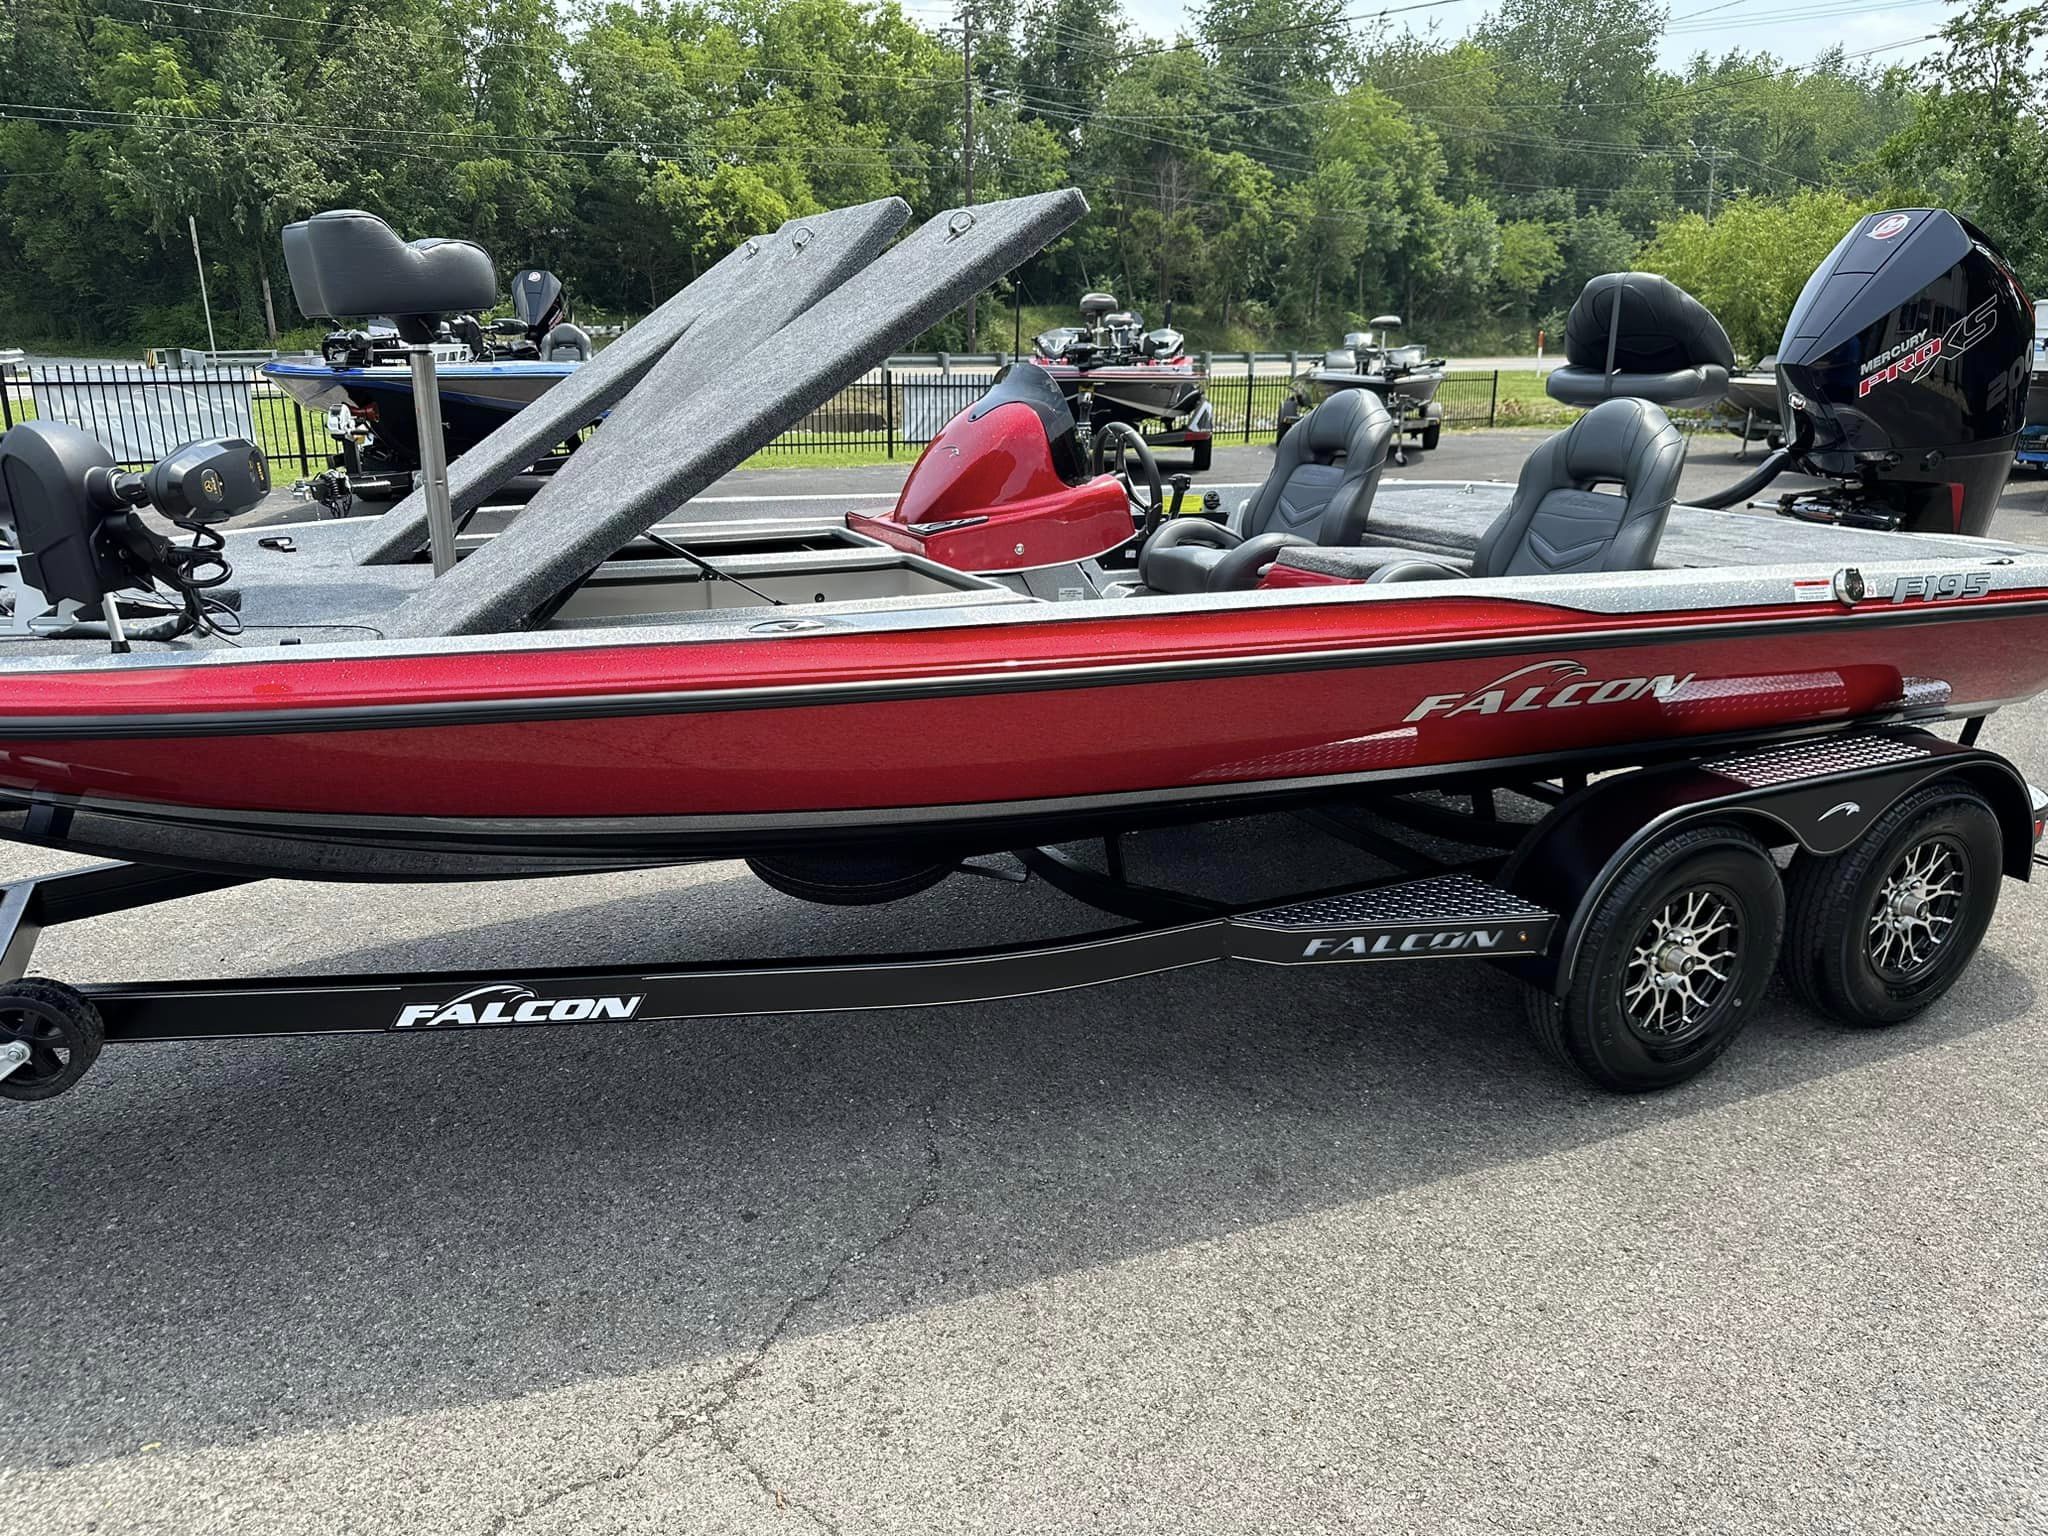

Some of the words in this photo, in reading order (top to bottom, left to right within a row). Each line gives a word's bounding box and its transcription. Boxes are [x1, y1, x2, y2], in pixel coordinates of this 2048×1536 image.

[1860, 328, 1928, 376] MERCURY
[1986, 338, 2034, 412] 200
[1891, 572, 1991, 604] F195
[1402, 672, 1696, 722] FALCON
[1302, 930, 1504, 957] FALCON
[395, 996, 641, 1027] FALCON
